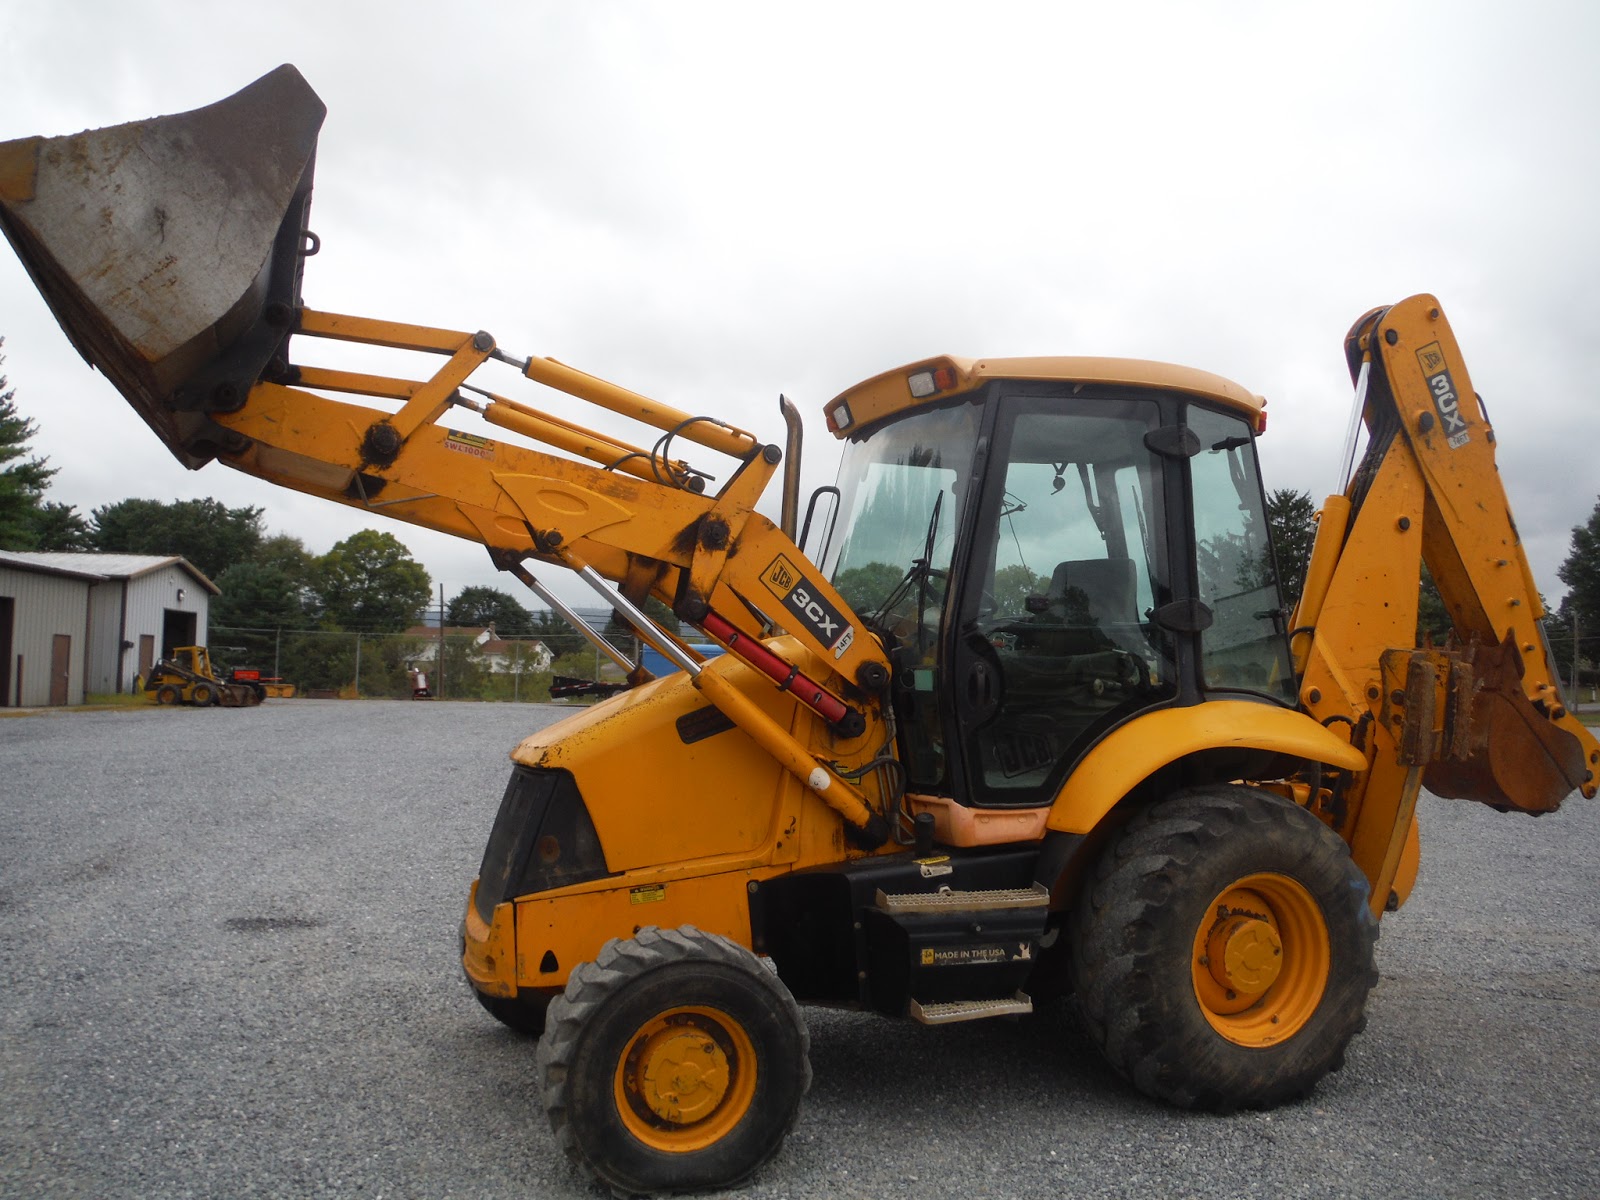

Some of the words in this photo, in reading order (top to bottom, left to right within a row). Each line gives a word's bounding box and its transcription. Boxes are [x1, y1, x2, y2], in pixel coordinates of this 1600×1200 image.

[1424, 352, 1440, 369] JCB
[1431, 374, 1465, 433] 3CX
[772, 565, 791, 589] JCB
[791, 588, 839, 639] 3CX
[836, 633, 853, 651] 14FT
[934, 951, 959, 960] MADE
[960, 950, 970, 959] IN
[971, 949, 988, 958] THE
[988, 948, 1006, 957] USA
